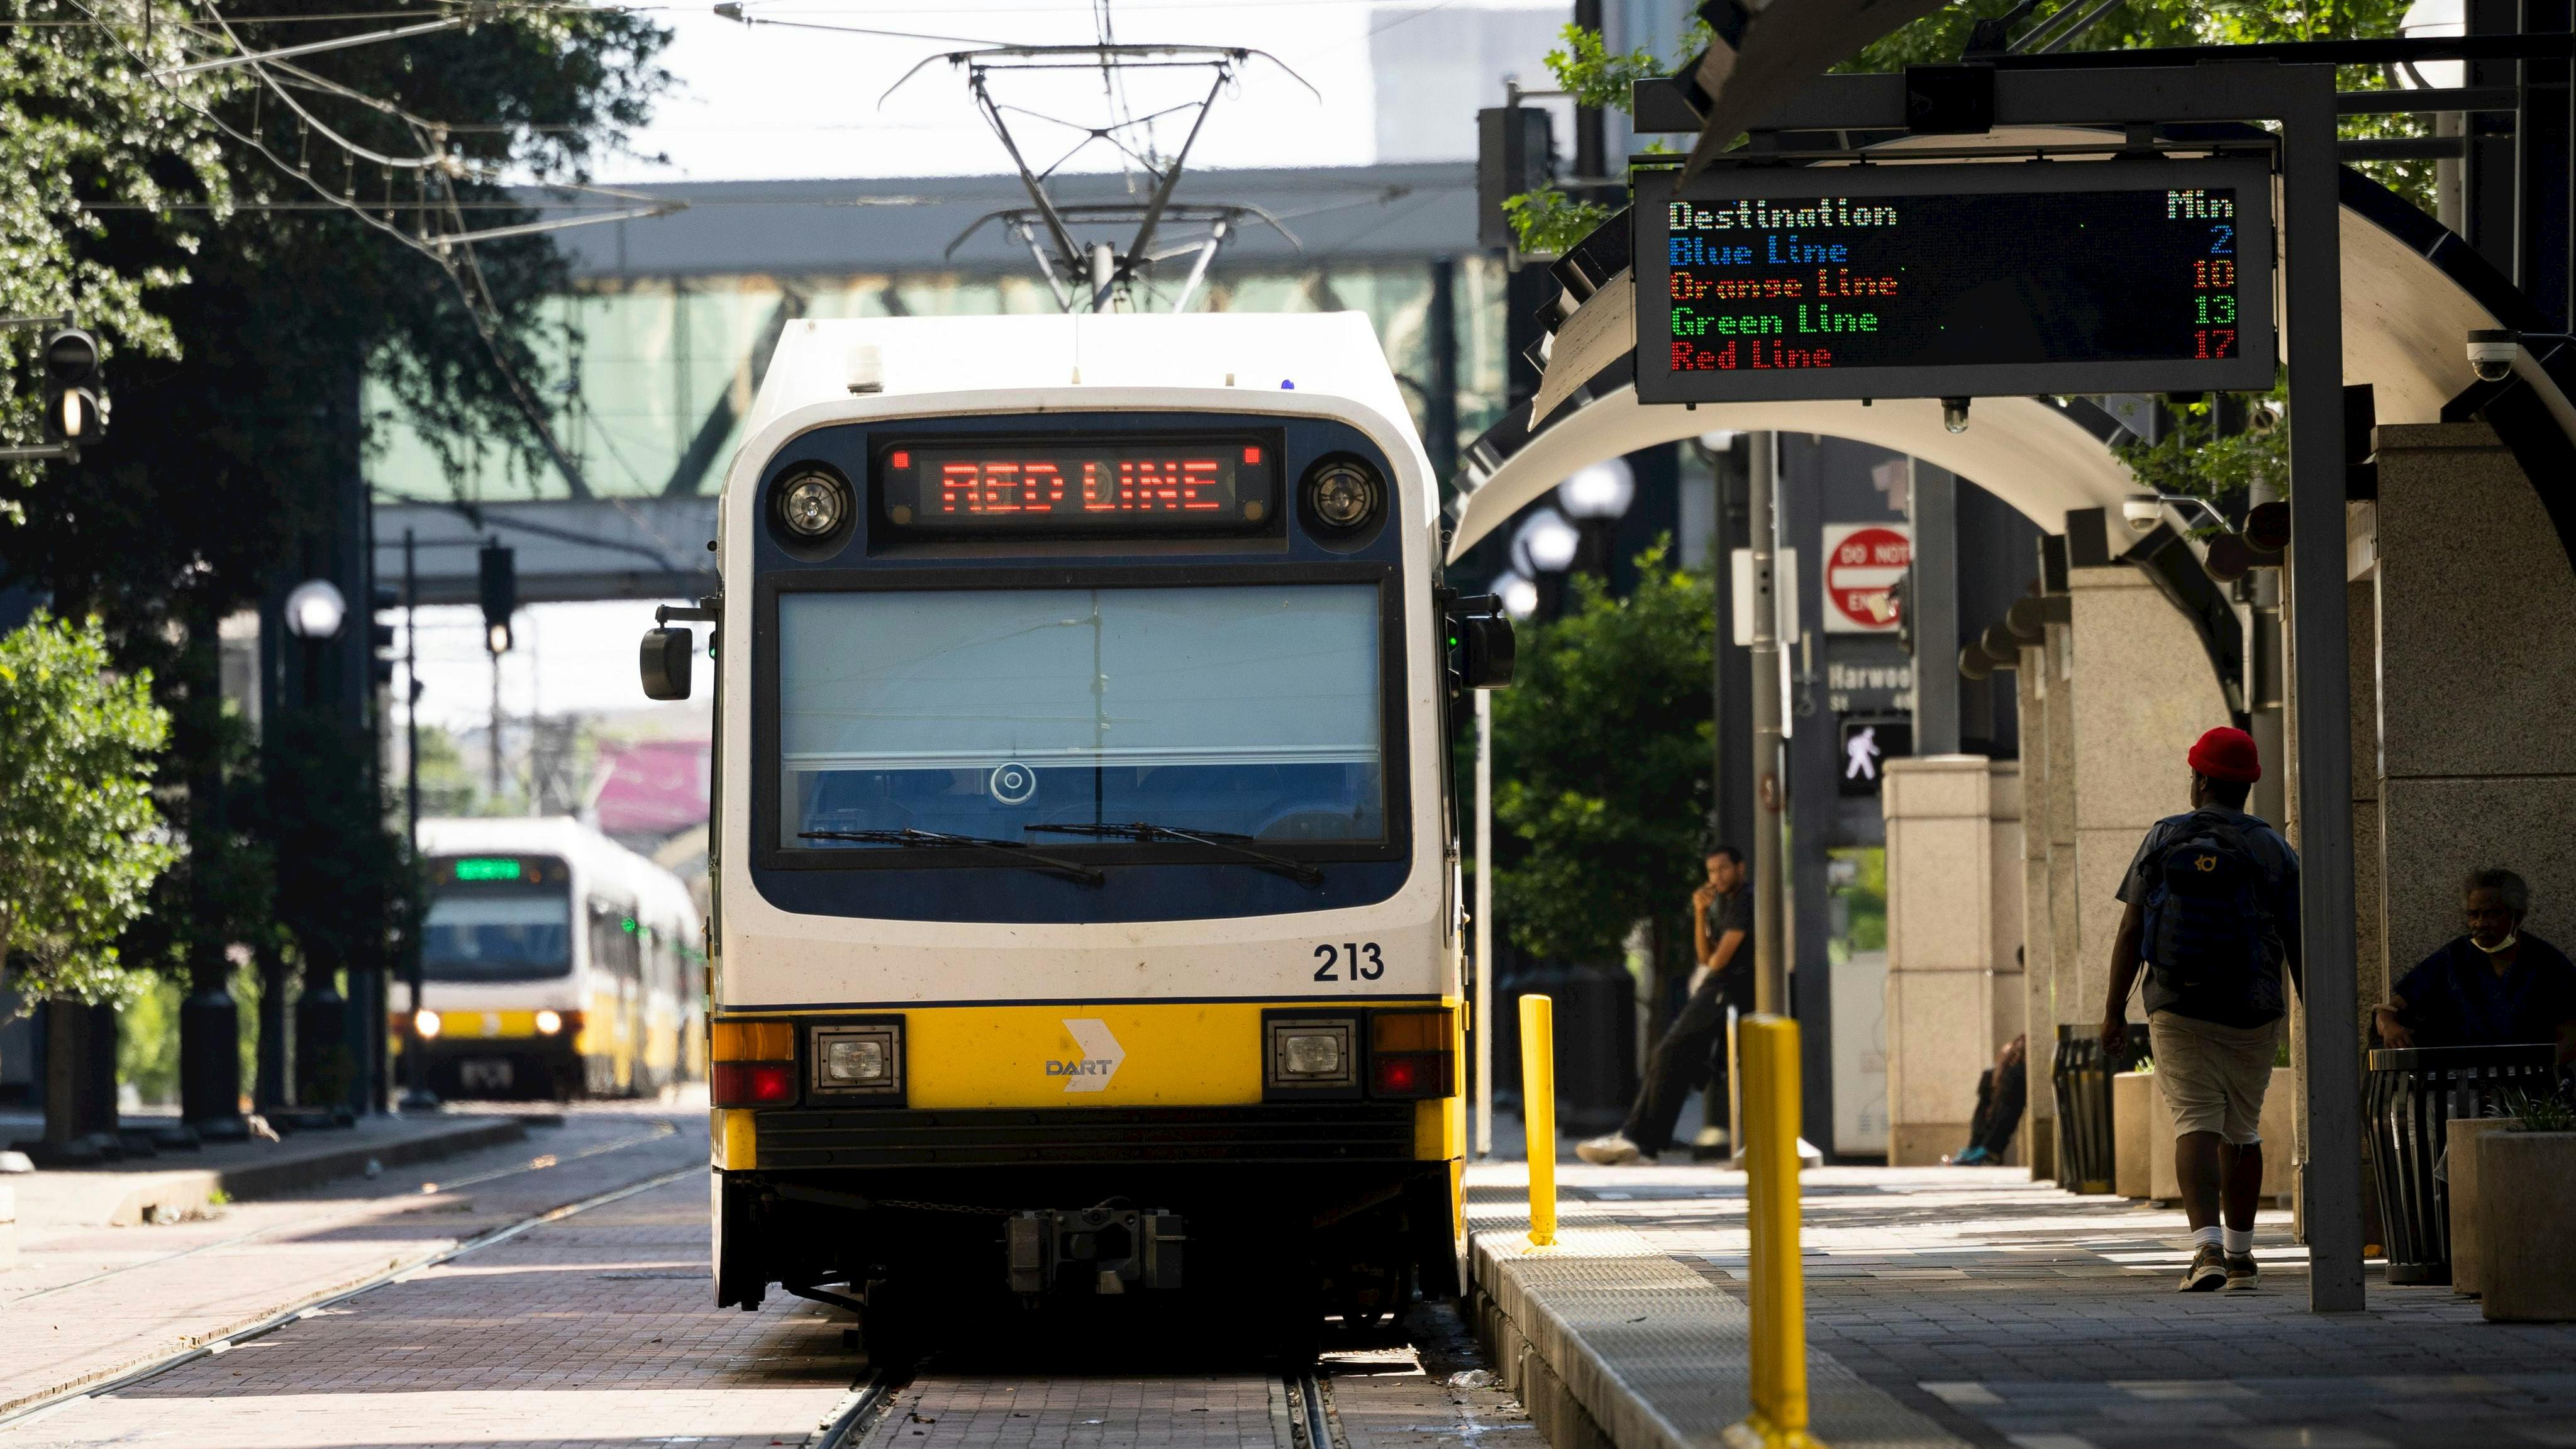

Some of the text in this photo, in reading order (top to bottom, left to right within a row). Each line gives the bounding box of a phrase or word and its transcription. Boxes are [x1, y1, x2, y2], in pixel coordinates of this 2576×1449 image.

[1670, 190, 2233, 230] Destination Min
[1670, 225, 2233, 265] Blue Line 2
[1670, 260, 2234, 300] Orange Line 10
[1672, 295, 2235, 335] Green Line 13
[1671, 330, 2235, 370] Red Line 17
[943, 462, 1219, 511] RED LINE
[1840, 543, 1910, 564] DO NOT
[1829, 664, 1912, 689] Harwoo
[1313, 942, 1384, 982] 213
[1046, 1059, 1113, 1076] DART
